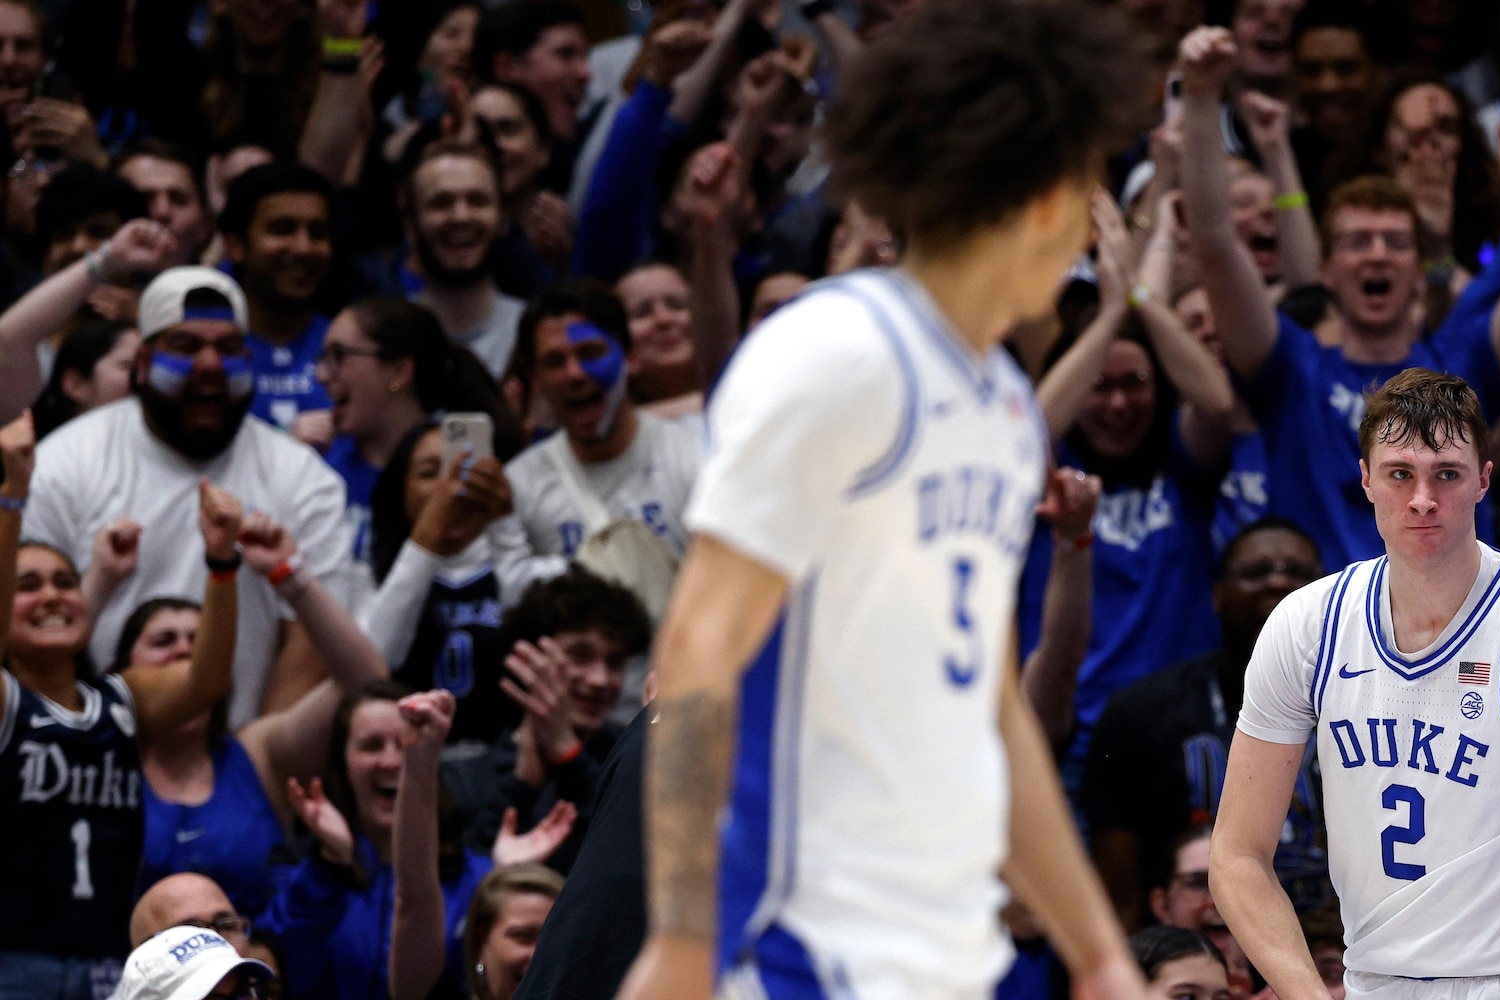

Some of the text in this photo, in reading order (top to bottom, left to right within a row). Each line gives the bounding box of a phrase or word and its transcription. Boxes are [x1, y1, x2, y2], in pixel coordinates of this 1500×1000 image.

[1329, 718, 1490, 788] DUKE
[70, 818, 95, 899] 1
[1380, 783, 1427, 882] 2
